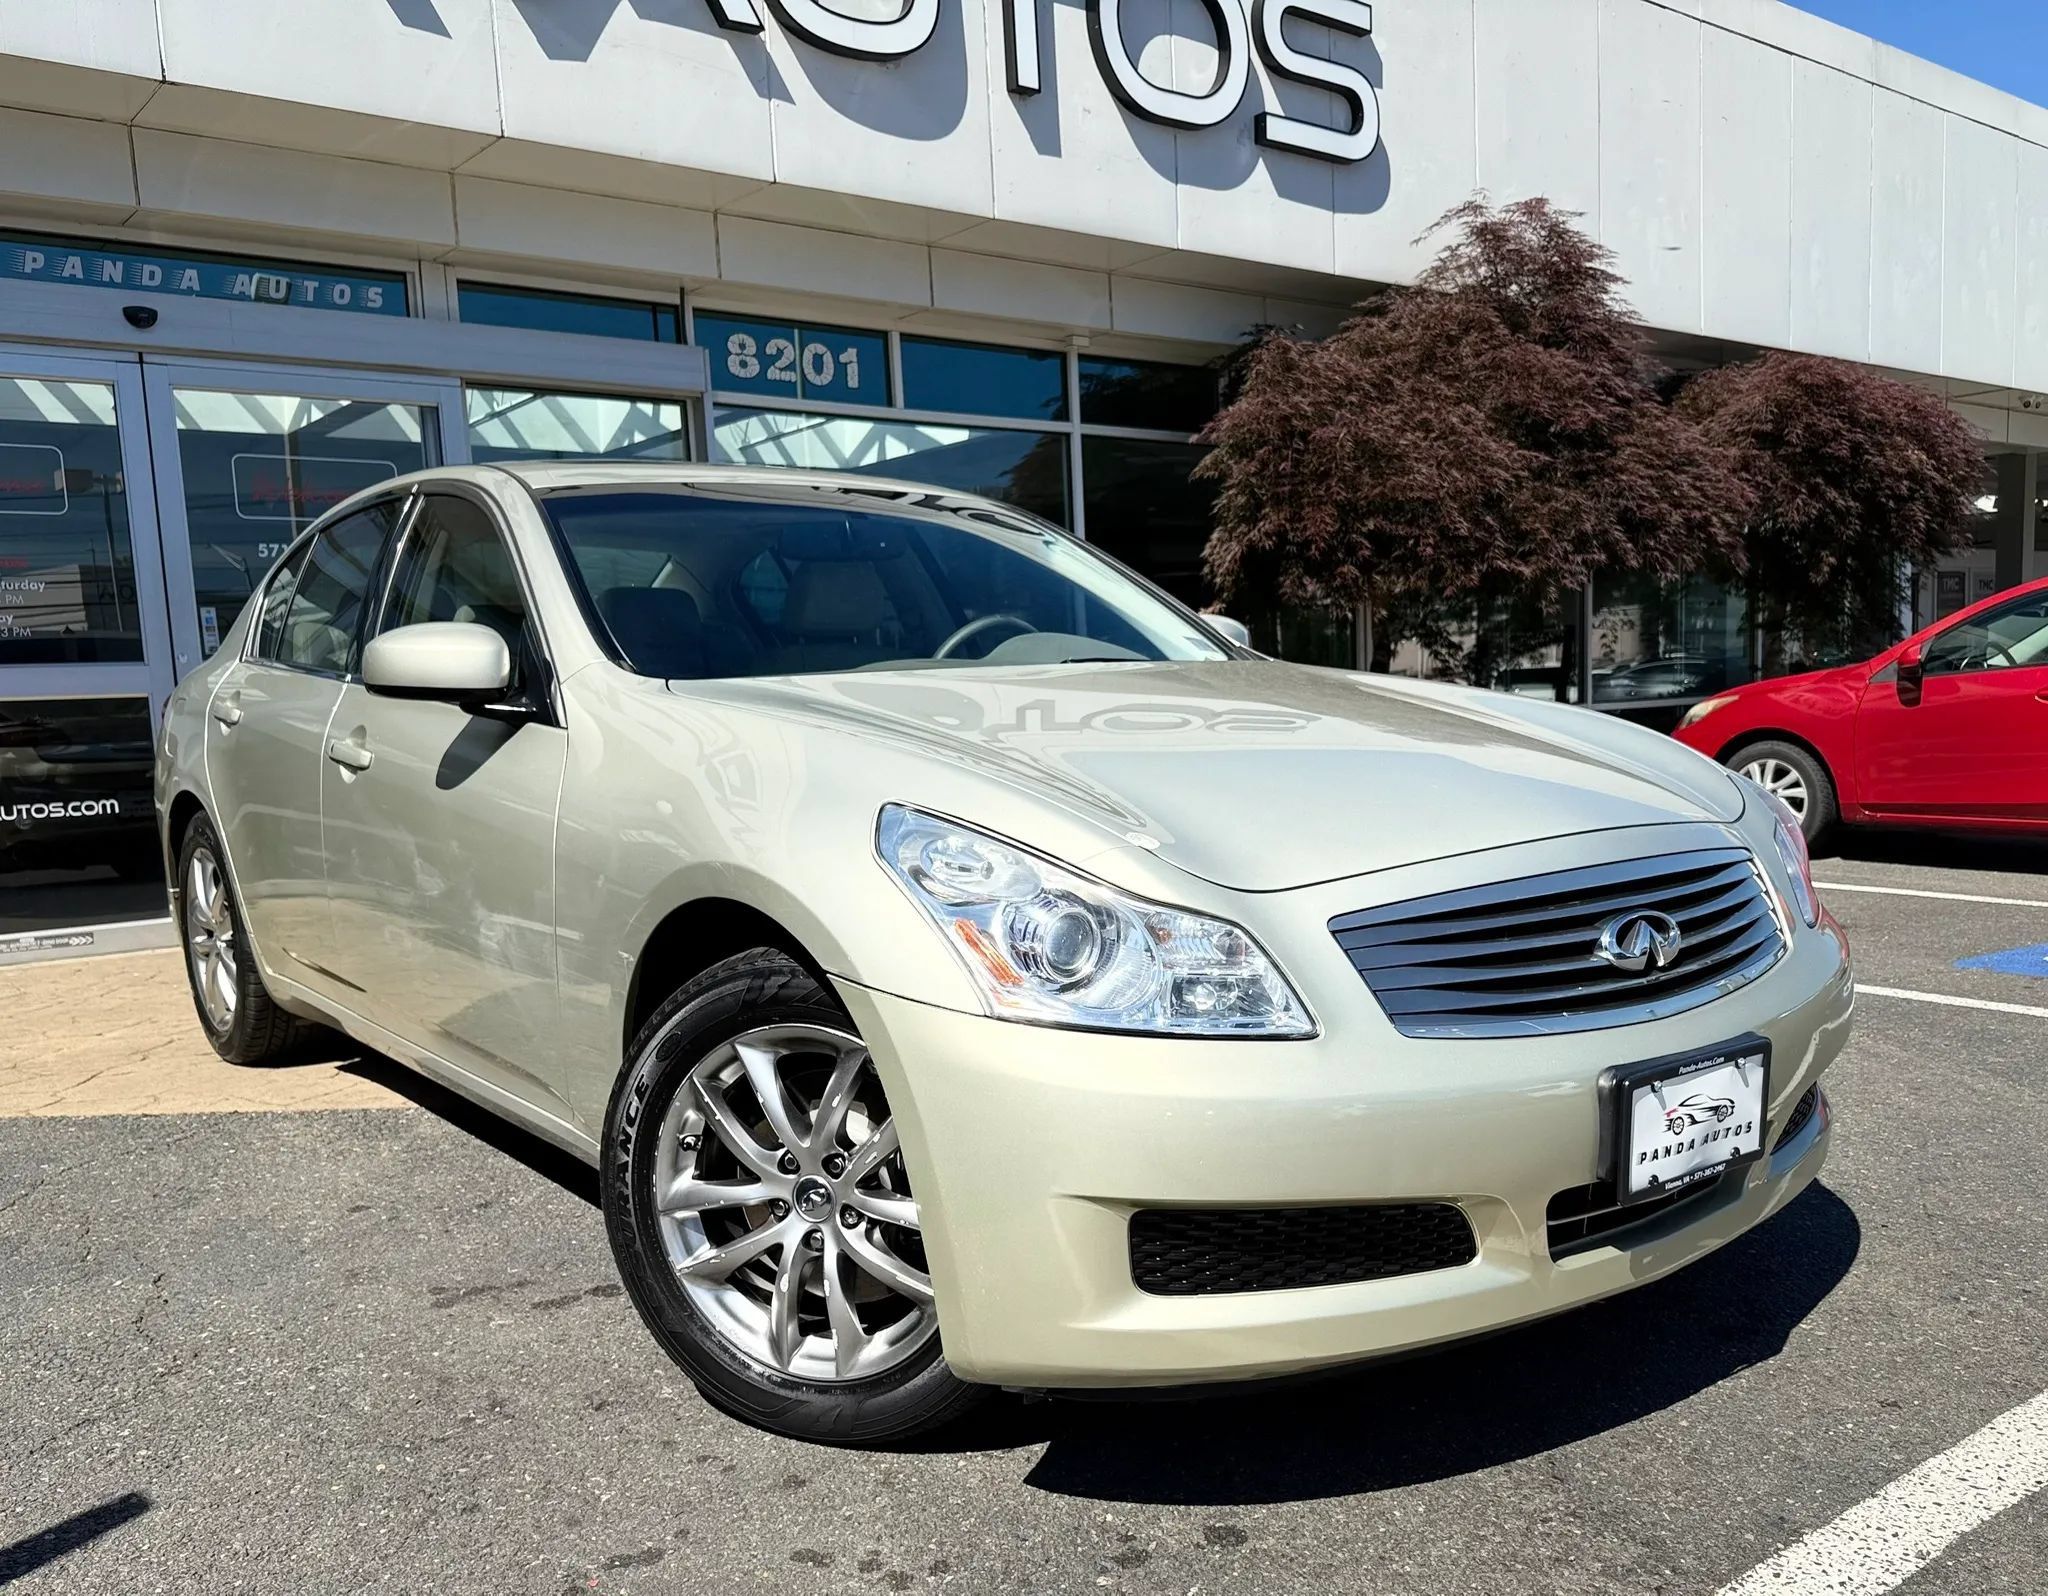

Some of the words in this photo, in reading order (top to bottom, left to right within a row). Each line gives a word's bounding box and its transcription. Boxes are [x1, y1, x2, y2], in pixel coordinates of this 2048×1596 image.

[8, 249, 201, 291] PANDA
[224, 272, 384, 309] AUTOS
[727, 333, 860, 389] 8201
[0, 580, 45, 592] turday
[5, 594, 24, 605] PM
[13, 627, 31, 637] PM
[1636, 1138, 1695, 1165] PANDA
[1701, 1121, 1752, 1147] AUTOS
